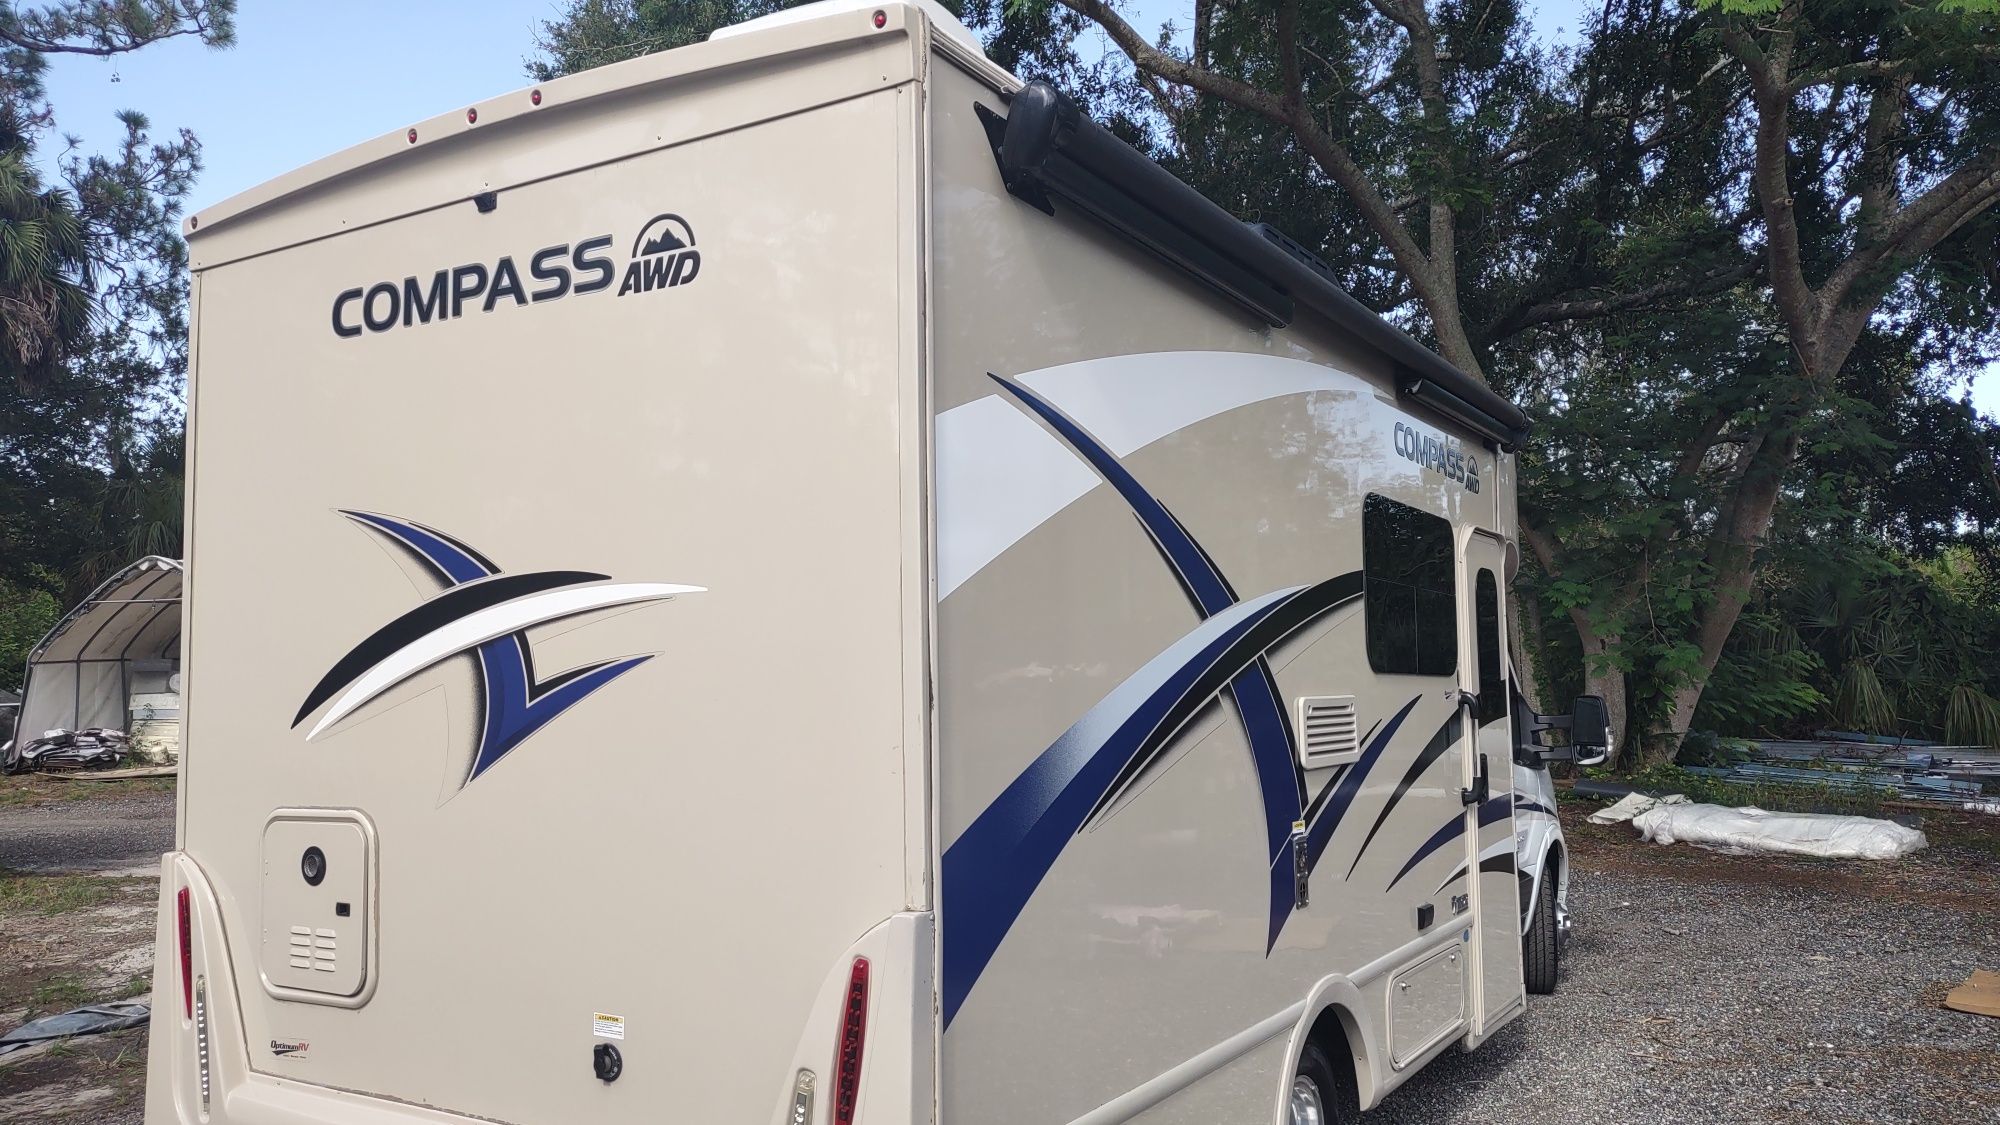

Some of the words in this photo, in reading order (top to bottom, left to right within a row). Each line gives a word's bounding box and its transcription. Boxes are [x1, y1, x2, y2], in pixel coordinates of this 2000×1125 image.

[331, 233, 616, 339] COMPASS
[617, 249, 701, 297] AWD
[1393, 421, 1465, 484] COMPASS
[1465, 473, 1480, 494] AWD
